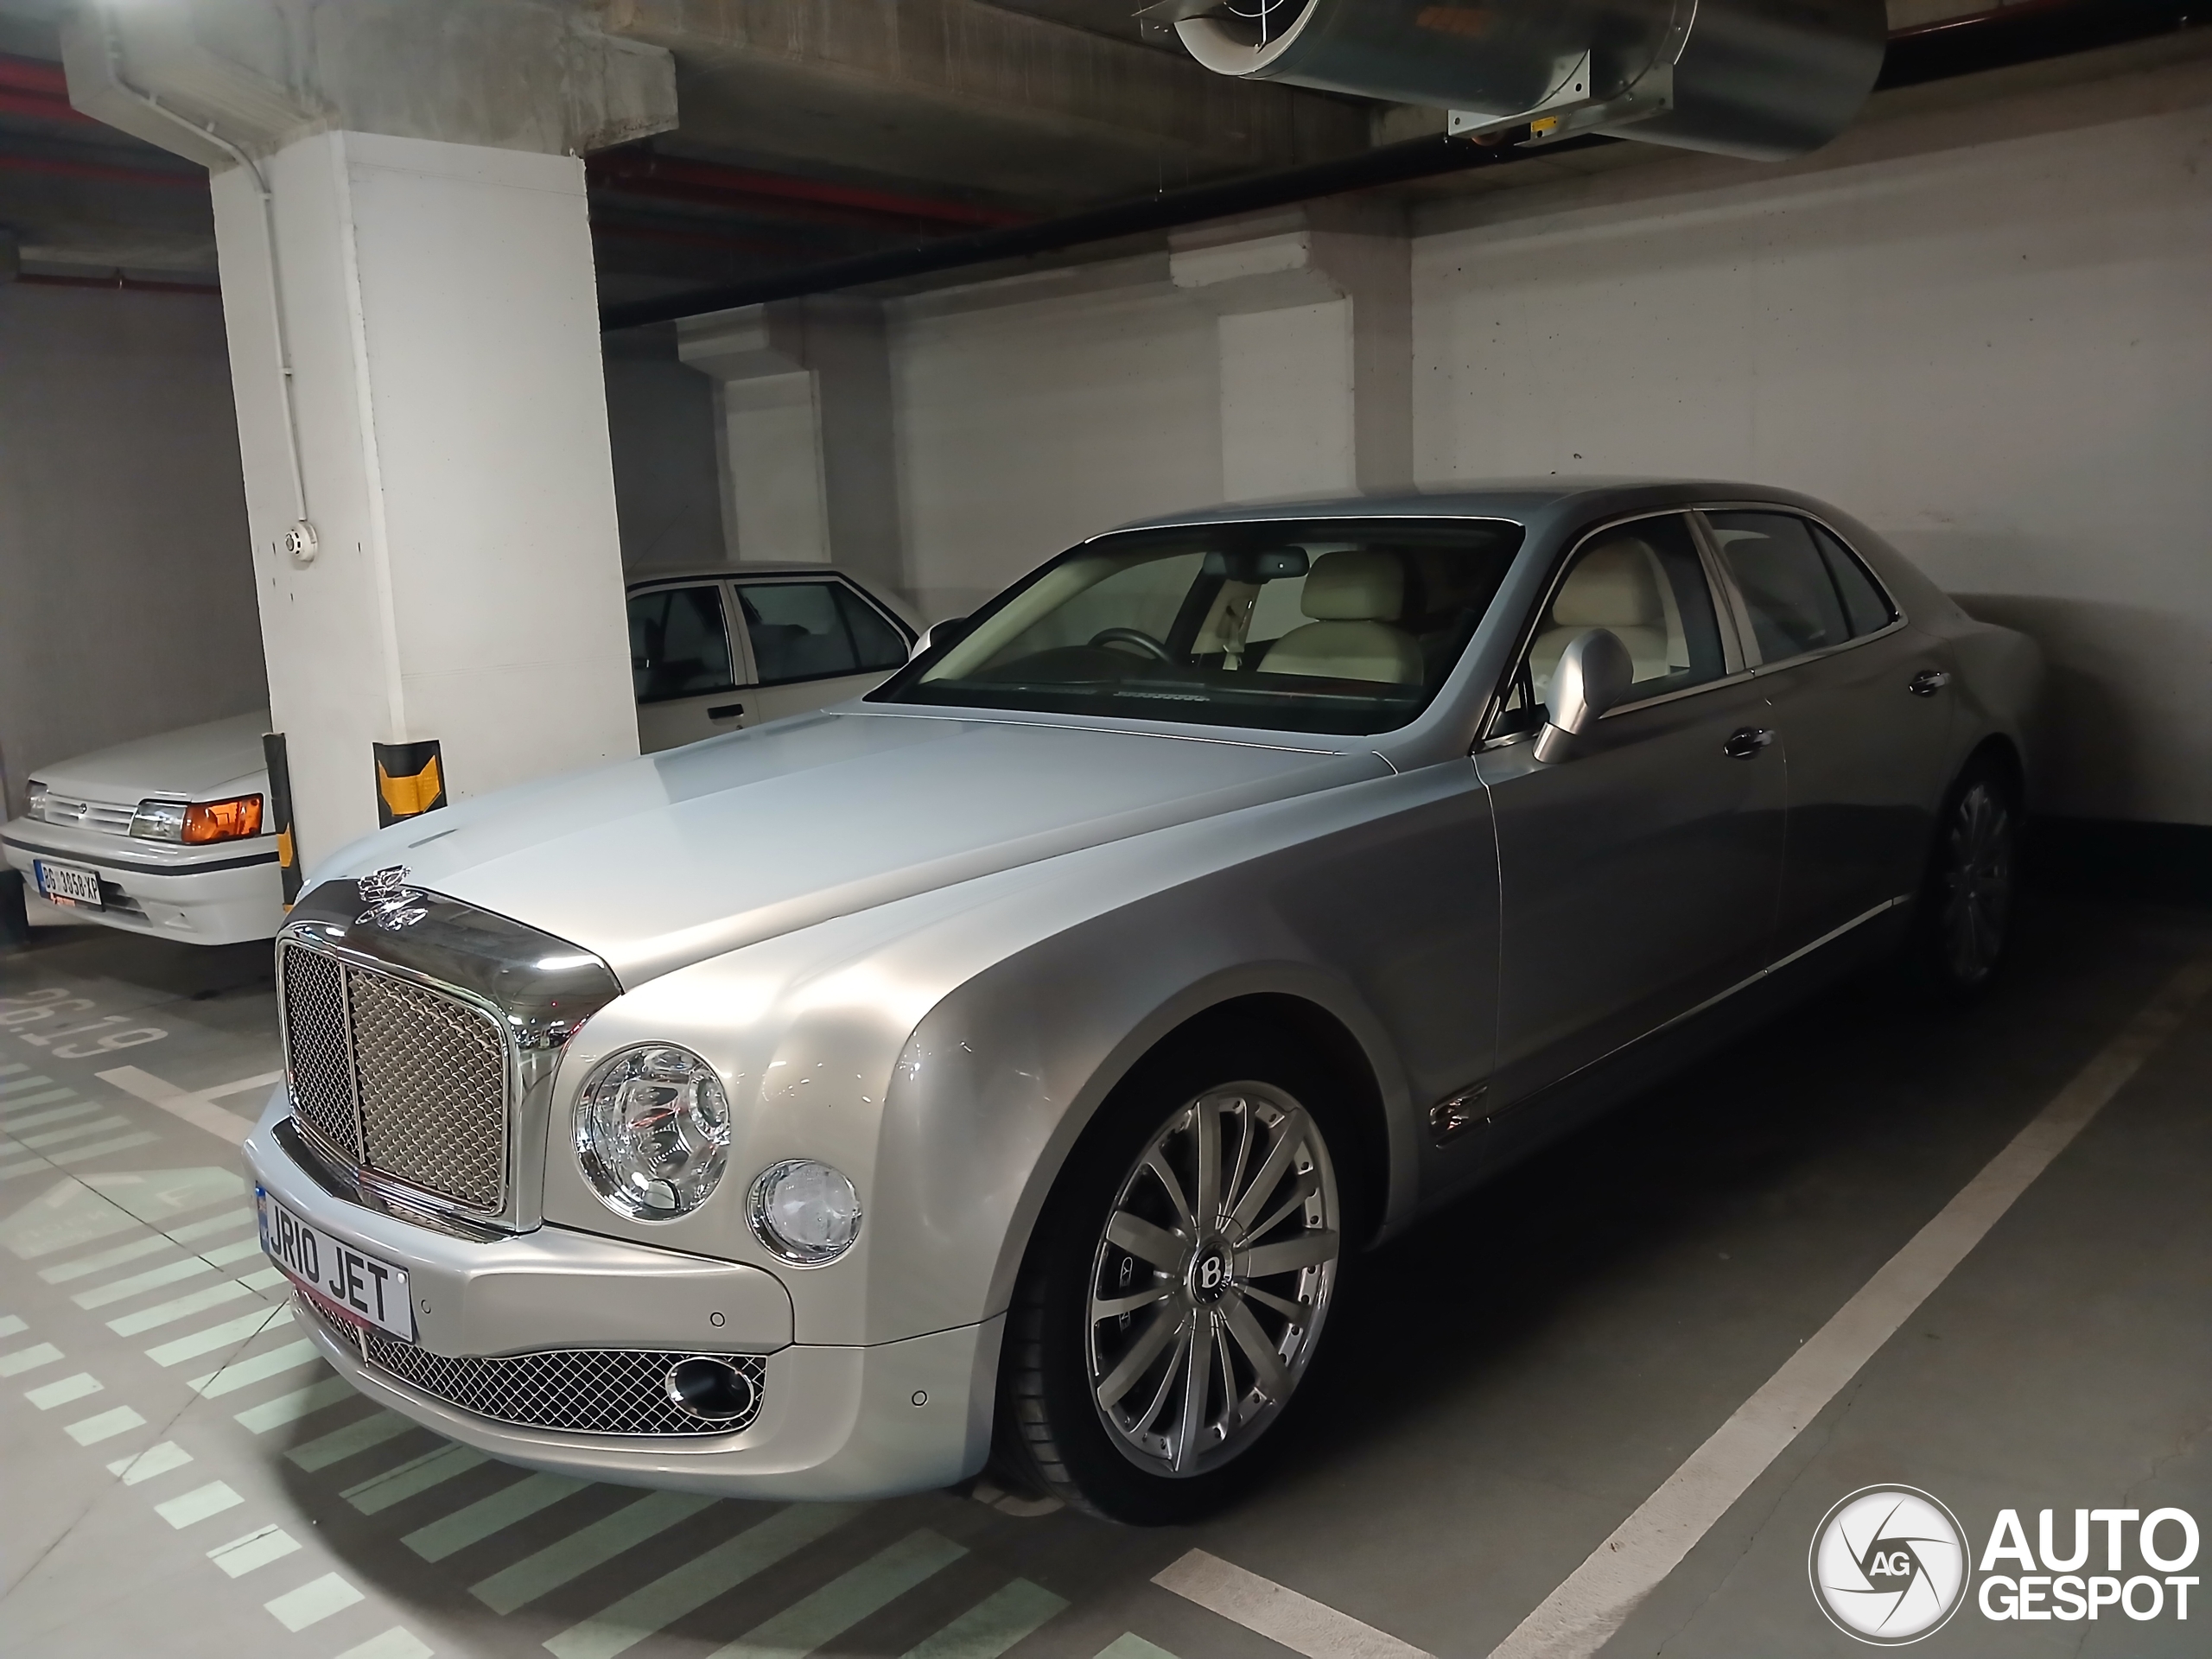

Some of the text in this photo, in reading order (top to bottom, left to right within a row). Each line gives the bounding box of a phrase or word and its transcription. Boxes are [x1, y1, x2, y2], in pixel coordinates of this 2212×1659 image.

[43, 867, 56, 890] BG
[270, 1205, 320, 1284] JR10
[328, 1246, 388, 1322] JET
